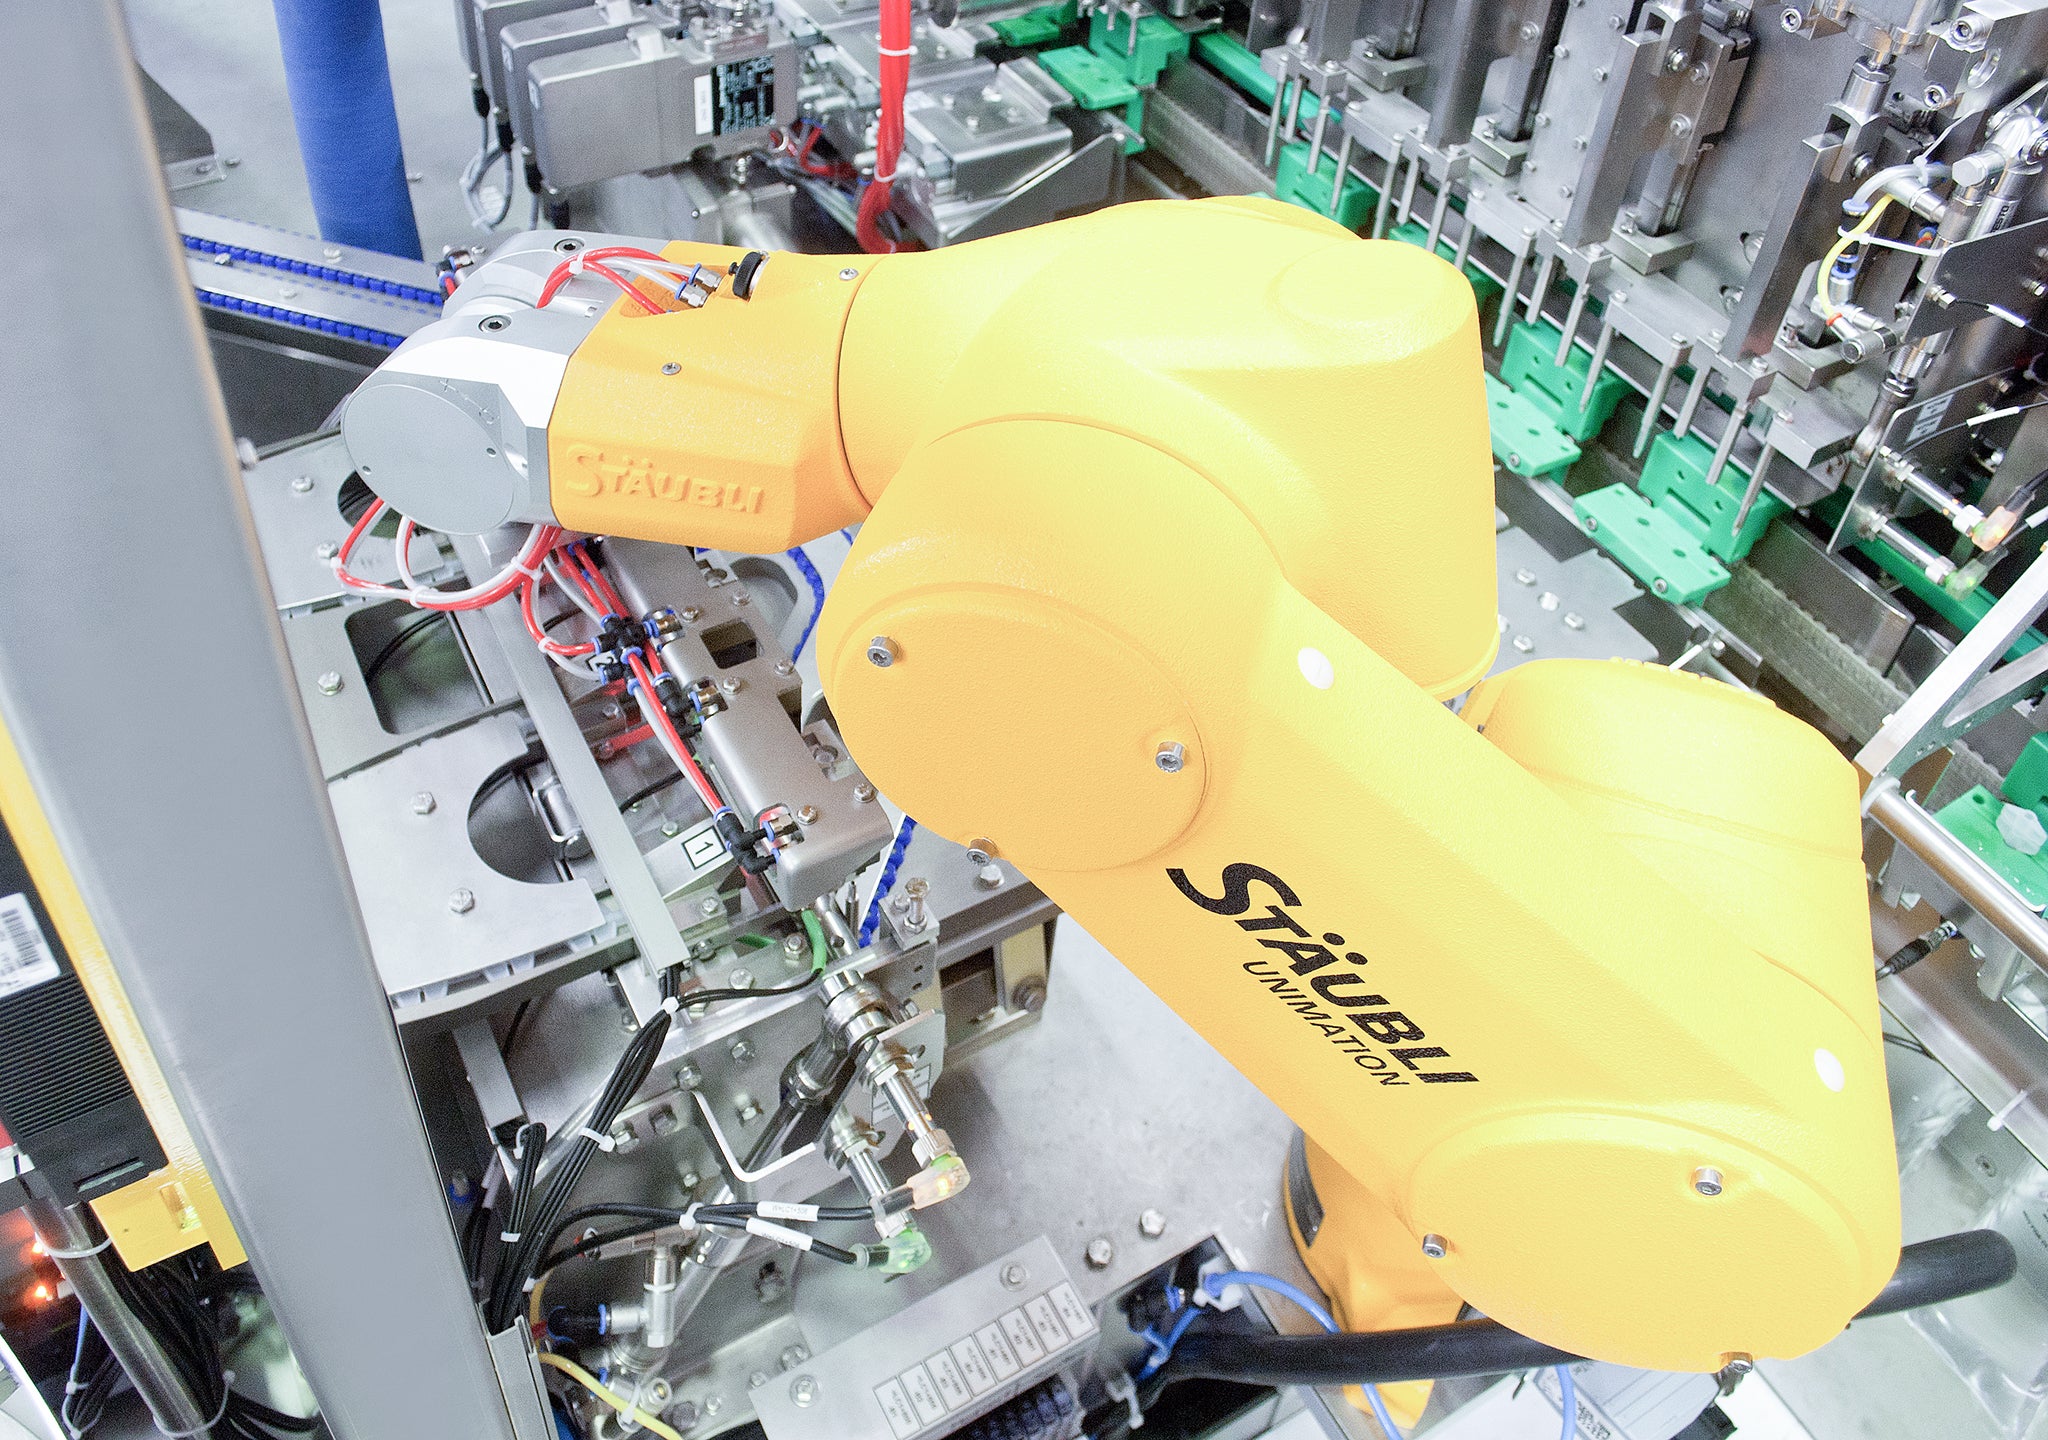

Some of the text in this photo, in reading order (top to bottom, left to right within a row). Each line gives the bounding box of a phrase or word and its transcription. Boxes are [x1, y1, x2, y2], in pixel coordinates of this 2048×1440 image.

[566, 443, 765, 514] STÄUBLI
[695, 841, 714, 855] 1
[1165, 862, 1480, 1083] STÄUBLI
[1242, 961, 1410, 1086] UNIMATION
